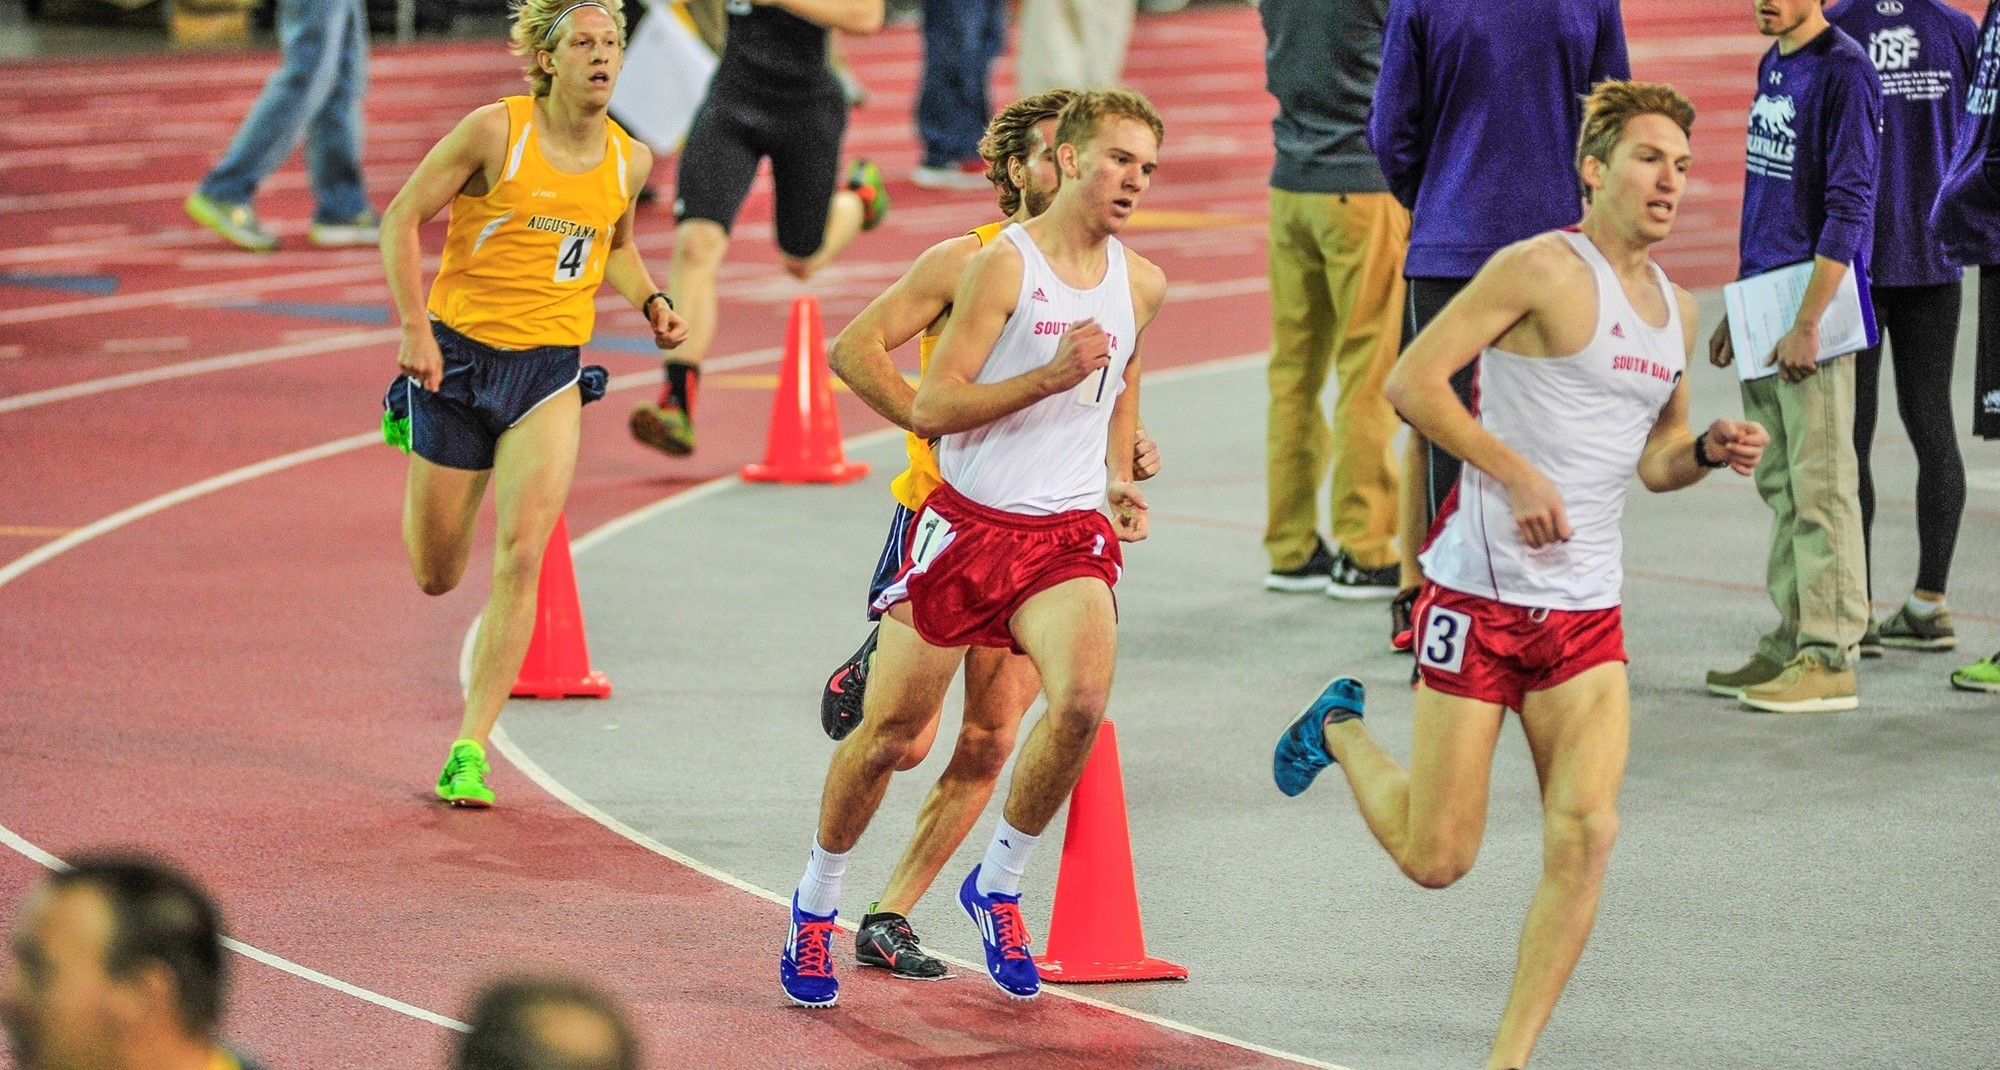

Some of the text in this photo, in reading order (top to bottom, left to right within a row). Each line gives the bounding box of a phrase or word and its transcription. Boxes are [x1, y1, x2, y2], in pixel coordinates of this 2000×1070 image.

[1869, 37, 1920, 72] USF
[527, 215, 597, 238] AUGUSTANA
[558, 238, 585, 278] 4
[1034, 321, 1071, 336] SOUT
[1613, 355, 1649, 374] SOUTH
[1426, 613, 1458, 665] 3
